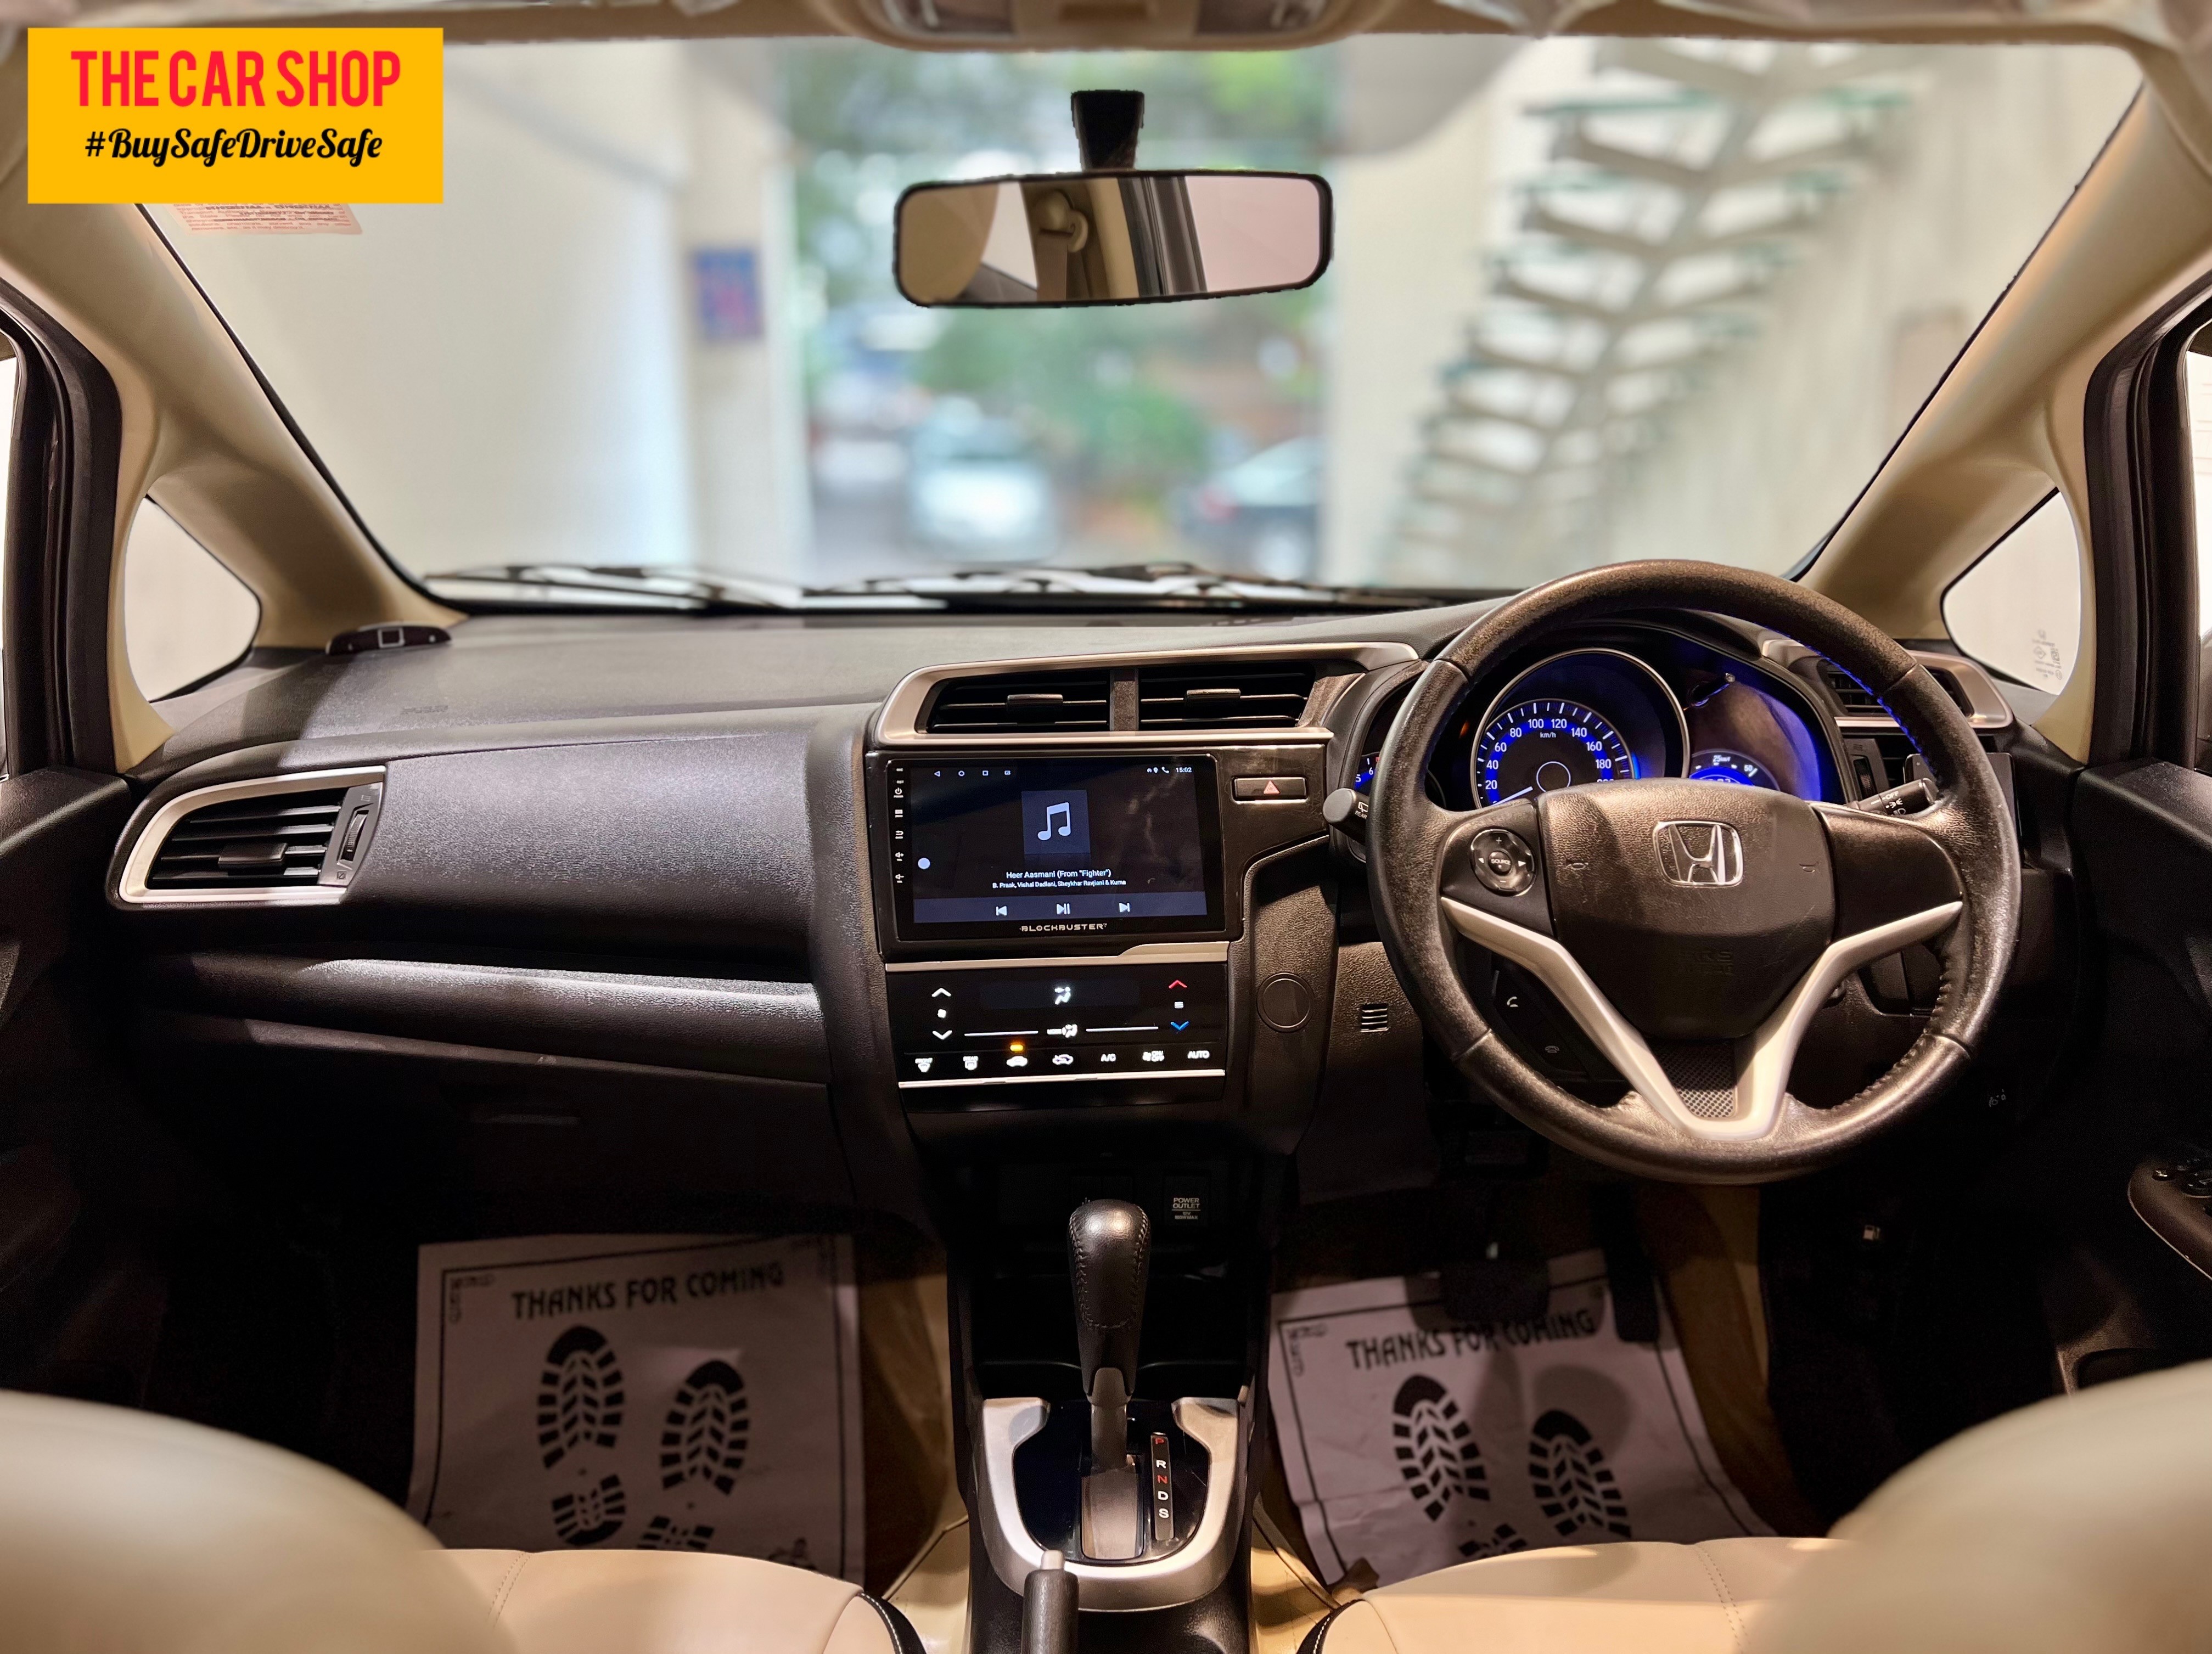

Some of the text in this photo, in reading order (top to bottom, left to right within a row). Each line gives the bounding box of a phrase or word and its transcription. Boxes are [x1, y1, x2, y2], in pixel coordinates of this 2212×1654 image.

[1528, 718, 1544, 729] 100
[1551, 718, 1568, 729] 120
[1509, 728, 1522, 738] 80
[1571, 728, 1587, 738] 140
[1495, 742, 1507, 752] 60
[1586, 741, 1603, 751] 160
[1486, 760, 1499, 769] 40
[1596, 759, 1612, 769] 180
[1368, 767, 1374, 775] 6
[1355, 774, 1362, 783] 5
[1485, 780, 1498, 790] 20
[1885, 790, 1899, 800] OFF
[1024, 870, 1056, 879] Aasmani
[1057, 870, 1078, 879] (From
[1101, 1053, 1117, 1062] A/C
[1187, 1050, 1210, 1059] AUTO
[512, 1261, 785, 1320] THANKS FOR COMING
[1345, 1309, 1595, 1370] THANKS FOR COMING
[1156, 1460, 1166, 1469] R
[1157, 1475, 1168, 1484] N
[1158, 1490, 1169, 1500] D
[1159, 1508, 1170, 1518] S
